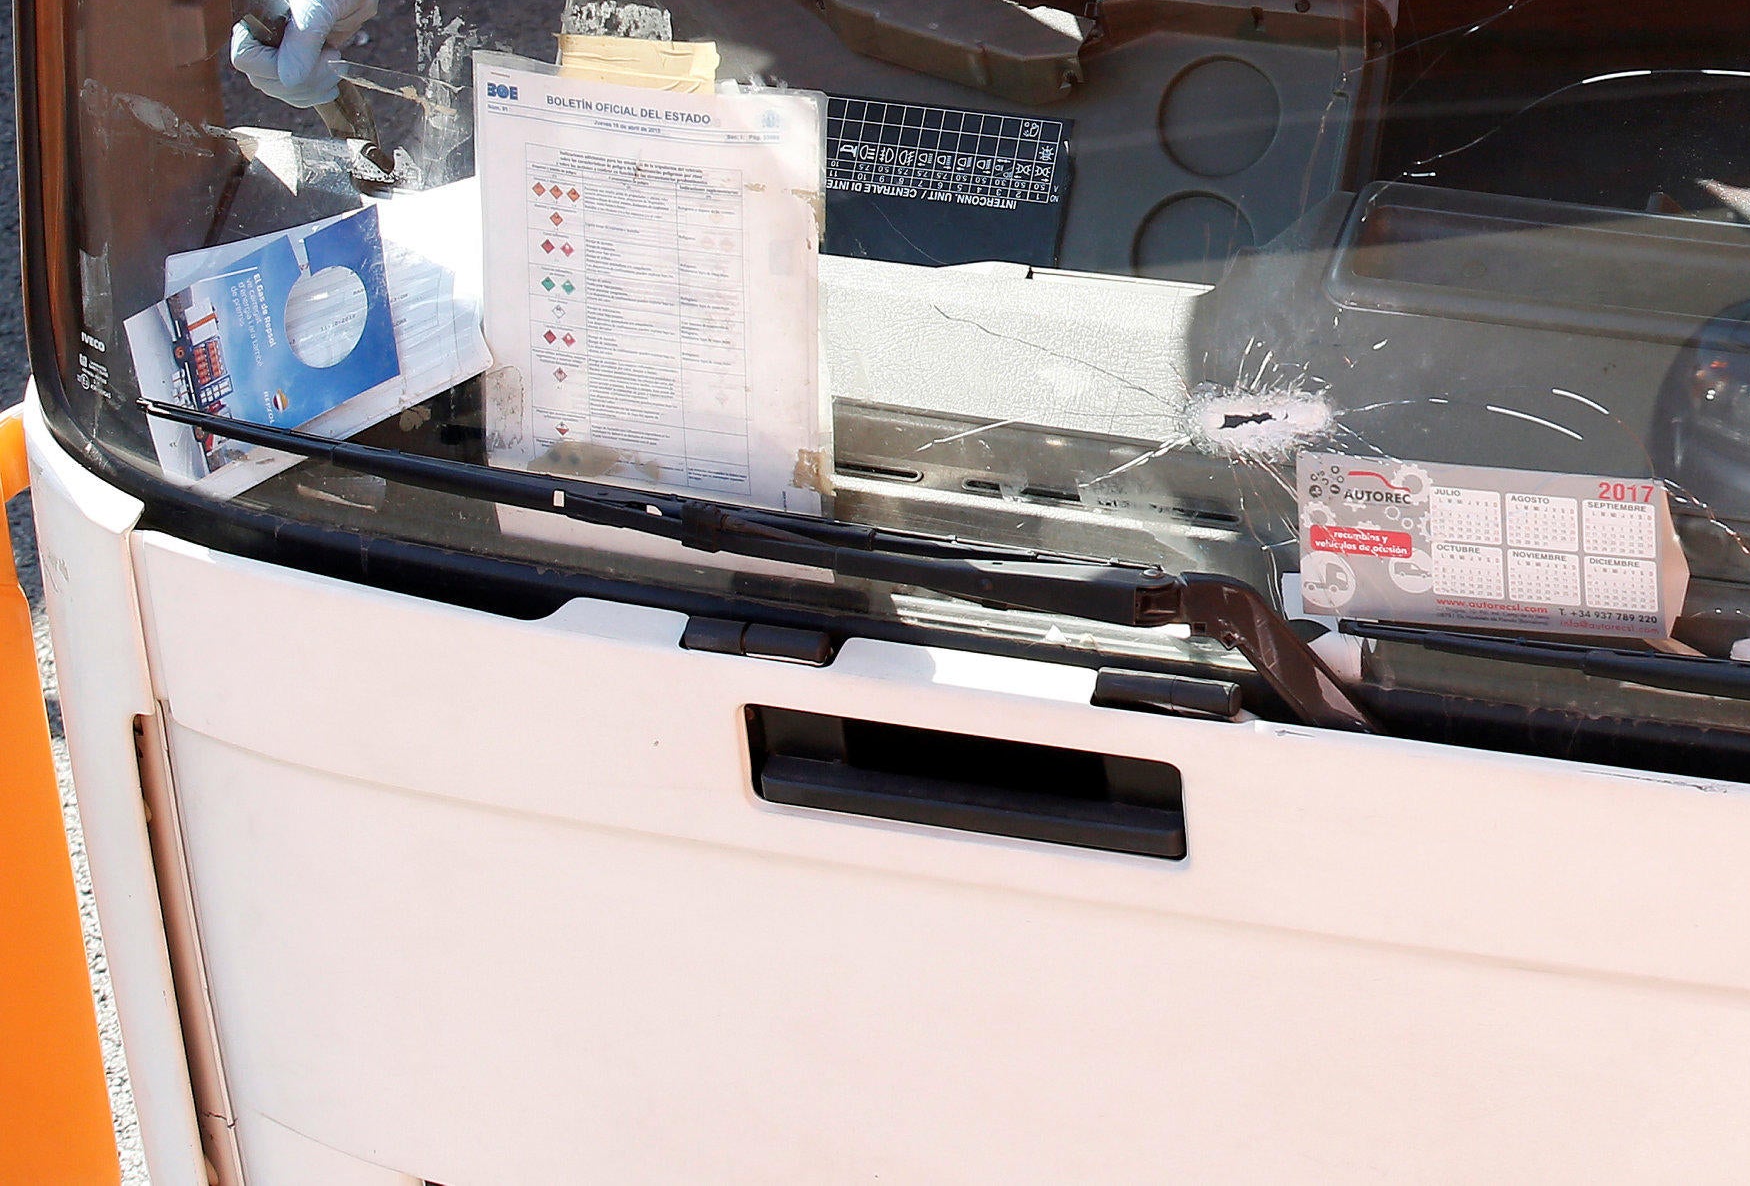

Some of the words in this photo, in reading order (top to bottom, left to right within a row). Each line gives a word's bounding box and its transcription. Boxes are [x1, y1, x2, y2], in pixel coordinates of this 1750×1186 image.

[545, 93, 593, 110] BOLETÍN
[595, 101, 638, 116] OFICIAL
[640, 107, 663, 119] DEL
[664, 109, 711, 125] ESTADO
[850, 182, 861, 191] DI
[863, 183, 917, 199] CENTRALE
[927, 190, 951, 202] UNIT
[955, 194, 1016, 210] INTERCONN.
[252, 273, 261, 283] El
[255, 285, 266, 302] Gas
[260, 303, 269, 315] de
[261, 316, 277, 347] Repsol
[81, 332, 105, 352] IVECO
[261, 391, 276, 424] REPSOL
[1344, 489, 1412, 505] AUTOREC
[1434, 487, 1461, 497] JULIO
[1599, 482, 1655, 503] 2017
[1510, 495, 1550, 504] AGOSTO
[1587, 501, 1647, 512] SEPTIEMBRE
[1334, 530, 1379, 542] recambios
[1315, 539, 1357, 552] vehículos
[1359, 544, 1371, 552] de
[1436, 544, 1480, 554] OCTUBRE
[1512, 550, 1567, 562] NOVIEMBRE
[1589, 557, 1640, 568] DICIEMBRE
[1436, 599, 1548, 613] www.autorecsl.com
[1571, 610, 1587, 618] +34
[1590, 610, 1612, 620] 937
[1614, 612, 1635, 621] 789
[1637, 613, 1658, 623] 220
[1560, 618, 1660, 634] info@autorecsl.com
